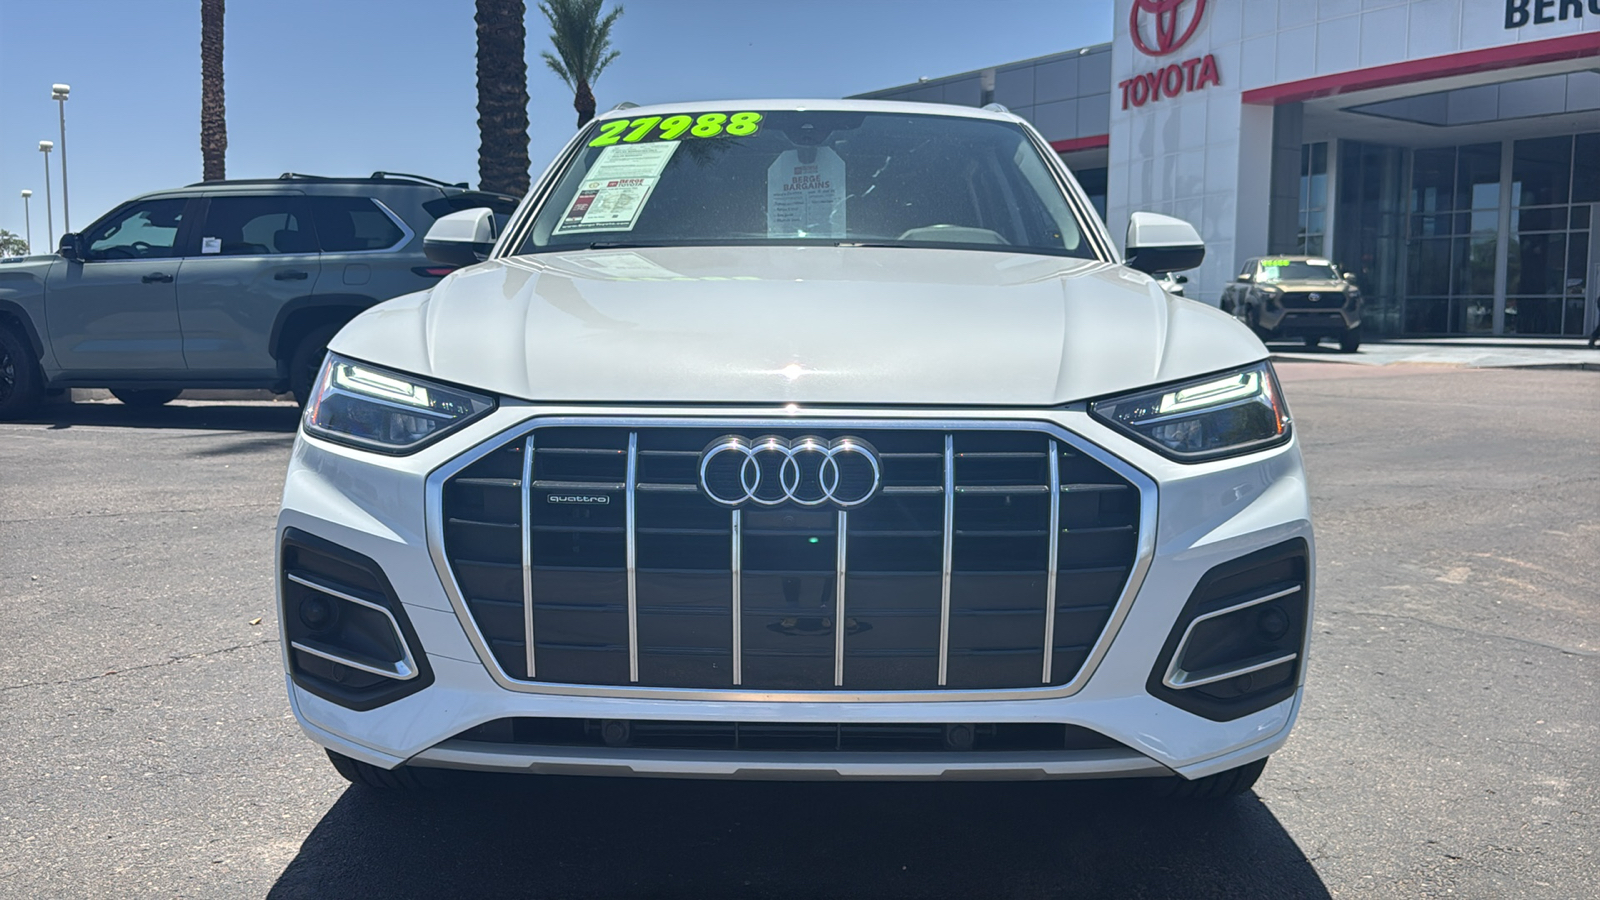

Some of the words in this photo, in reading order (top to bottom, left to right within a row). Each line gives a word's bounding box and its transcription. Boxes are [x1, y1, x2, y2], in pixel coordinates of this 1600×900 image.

[1118, 54, 1220, 111] TOYOTA
[588, 111, 763, 147] 27988
[792, 175, 821, 184] BERGE
[783, 181, 830, 191] BARGAINS
[549, 495, 607, 503] quattro
